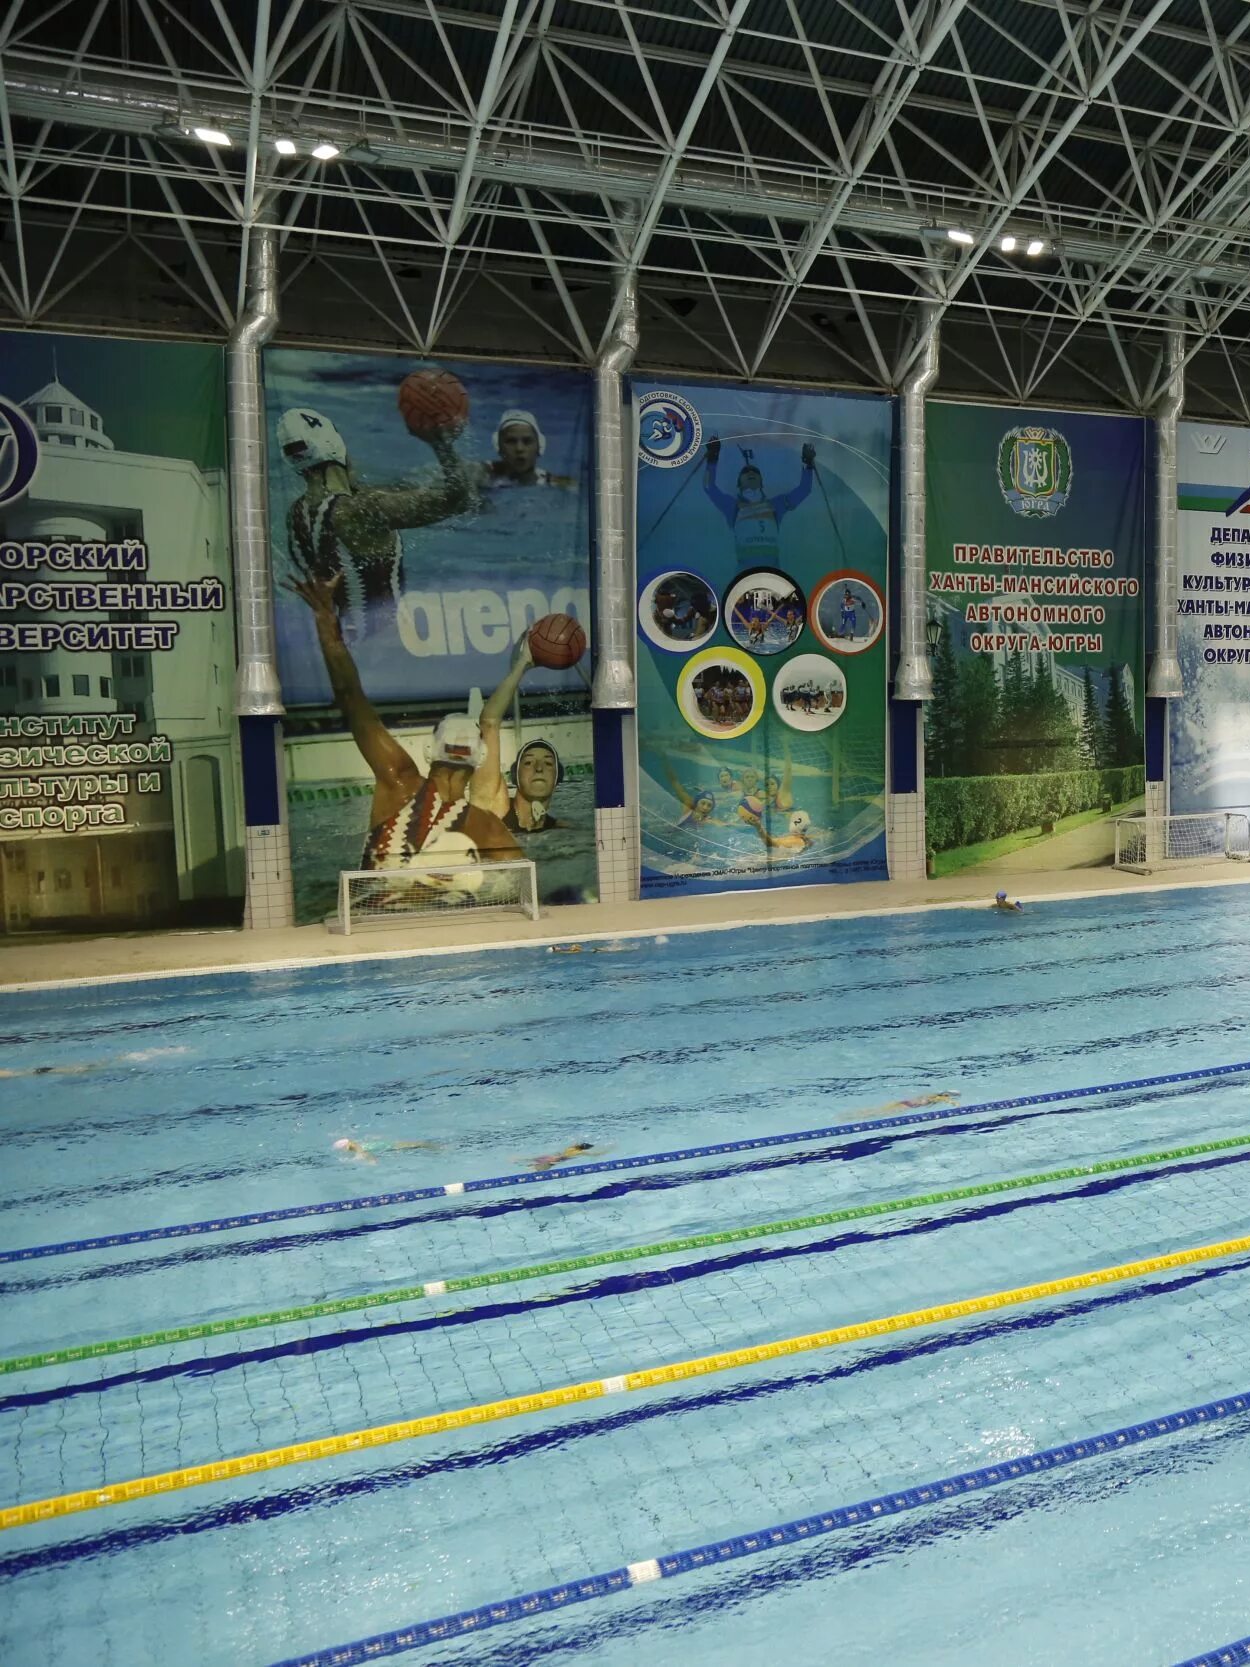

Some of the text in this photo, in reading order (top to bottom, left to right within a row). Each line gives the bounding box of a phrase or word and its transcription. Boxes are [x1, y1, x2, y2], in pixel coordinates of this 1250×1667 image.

[639, 393, 678, 405] ОДГОТОВКИ
[300, 413, 322, 429] 4
[1021, 499, 1050, 511] ЮГРА
[0, 540, 146, 570] ОРСКИЙ
[954, 544, 1114, 568] ПРАВИТЕЛЬСТВО
[0, 578, 224, 609] РСТВЕННЫЙ
[930, 572, 1139, 596] ХАНТЫ-МАНСИЙСКОГО
[966, 603, 1106, 624] АВТОНОМНОГО
[971, 632, 1103, 652] ОКРУГА-ЮГРЫ
[138, 772, 161, 792] и
[0, 803, 125, 832] спорта
